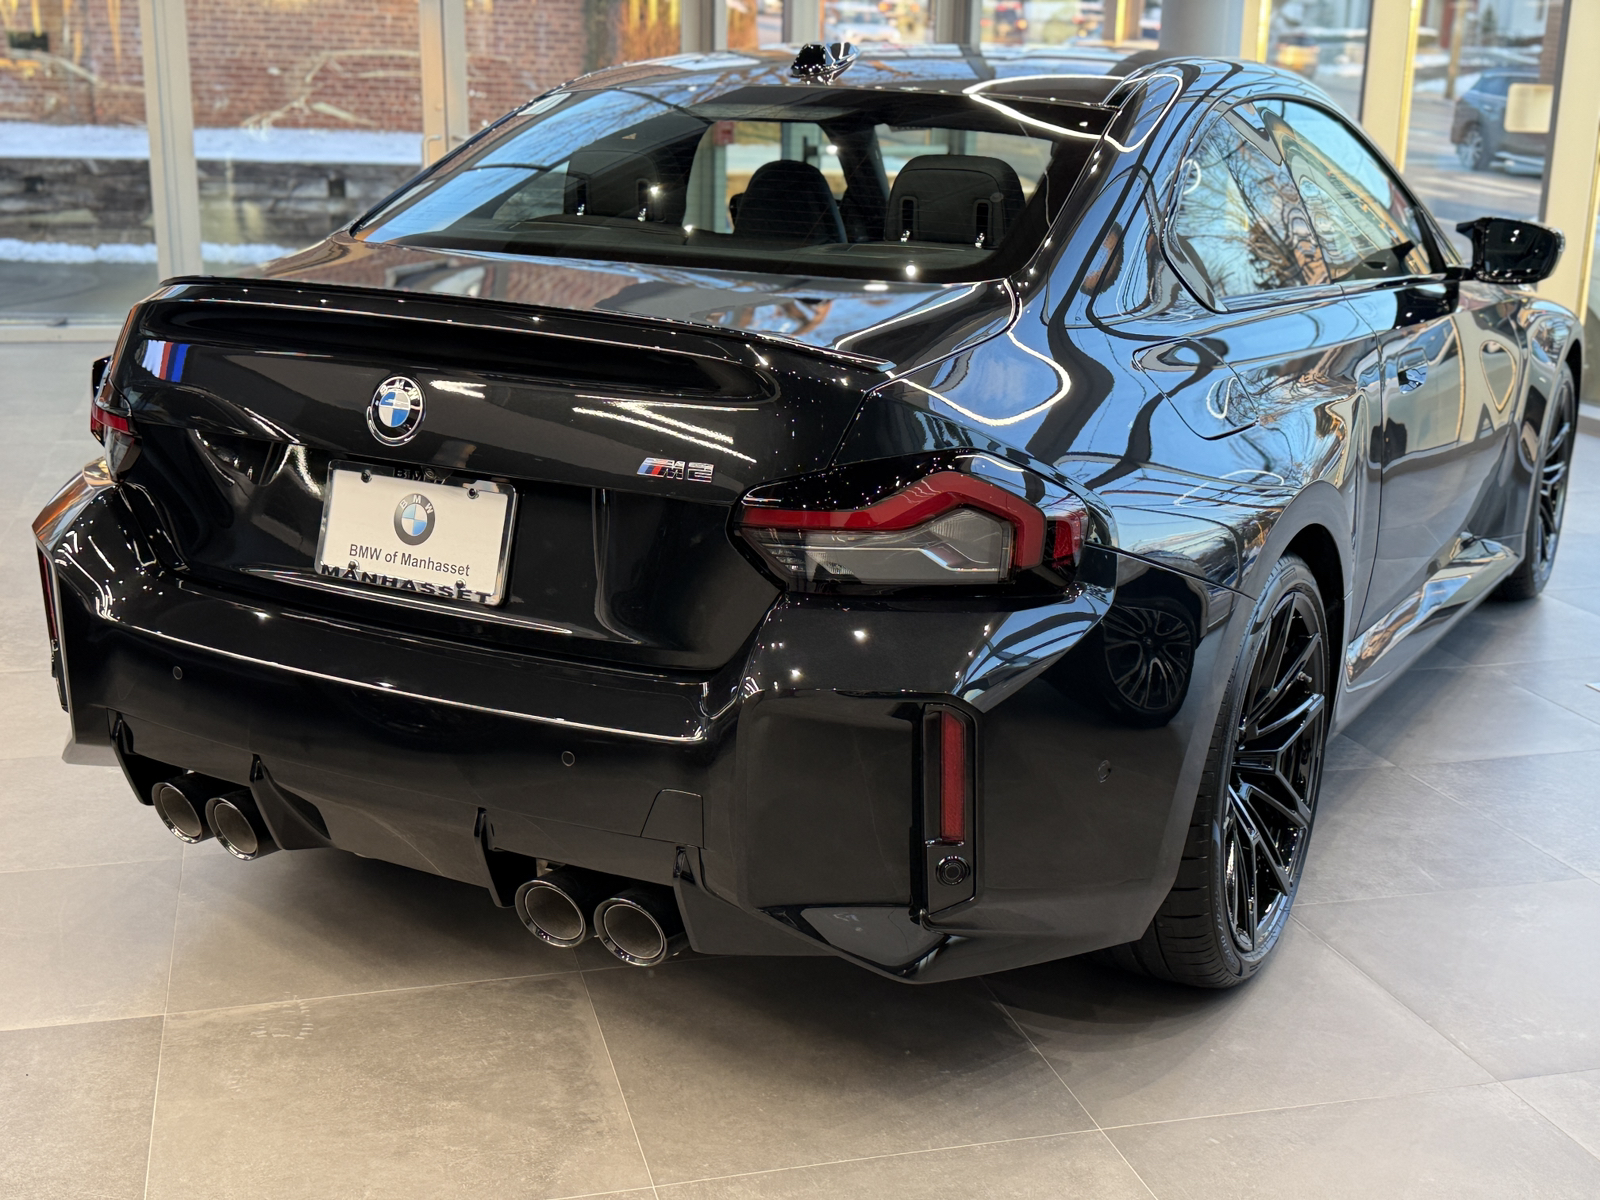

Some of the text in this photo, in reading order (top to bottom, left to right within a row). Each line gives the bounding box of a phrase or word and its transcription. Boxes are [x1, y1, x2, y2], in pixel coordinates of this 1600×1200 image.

[379, 379, 420, 401] BMW
[637, 457, 714, 483] M2
[399, 494, 434, 514] BMW
[349, 543, 471, 577] BMW of Manhasset
[321, 564, 493, 603] MANHASSET
